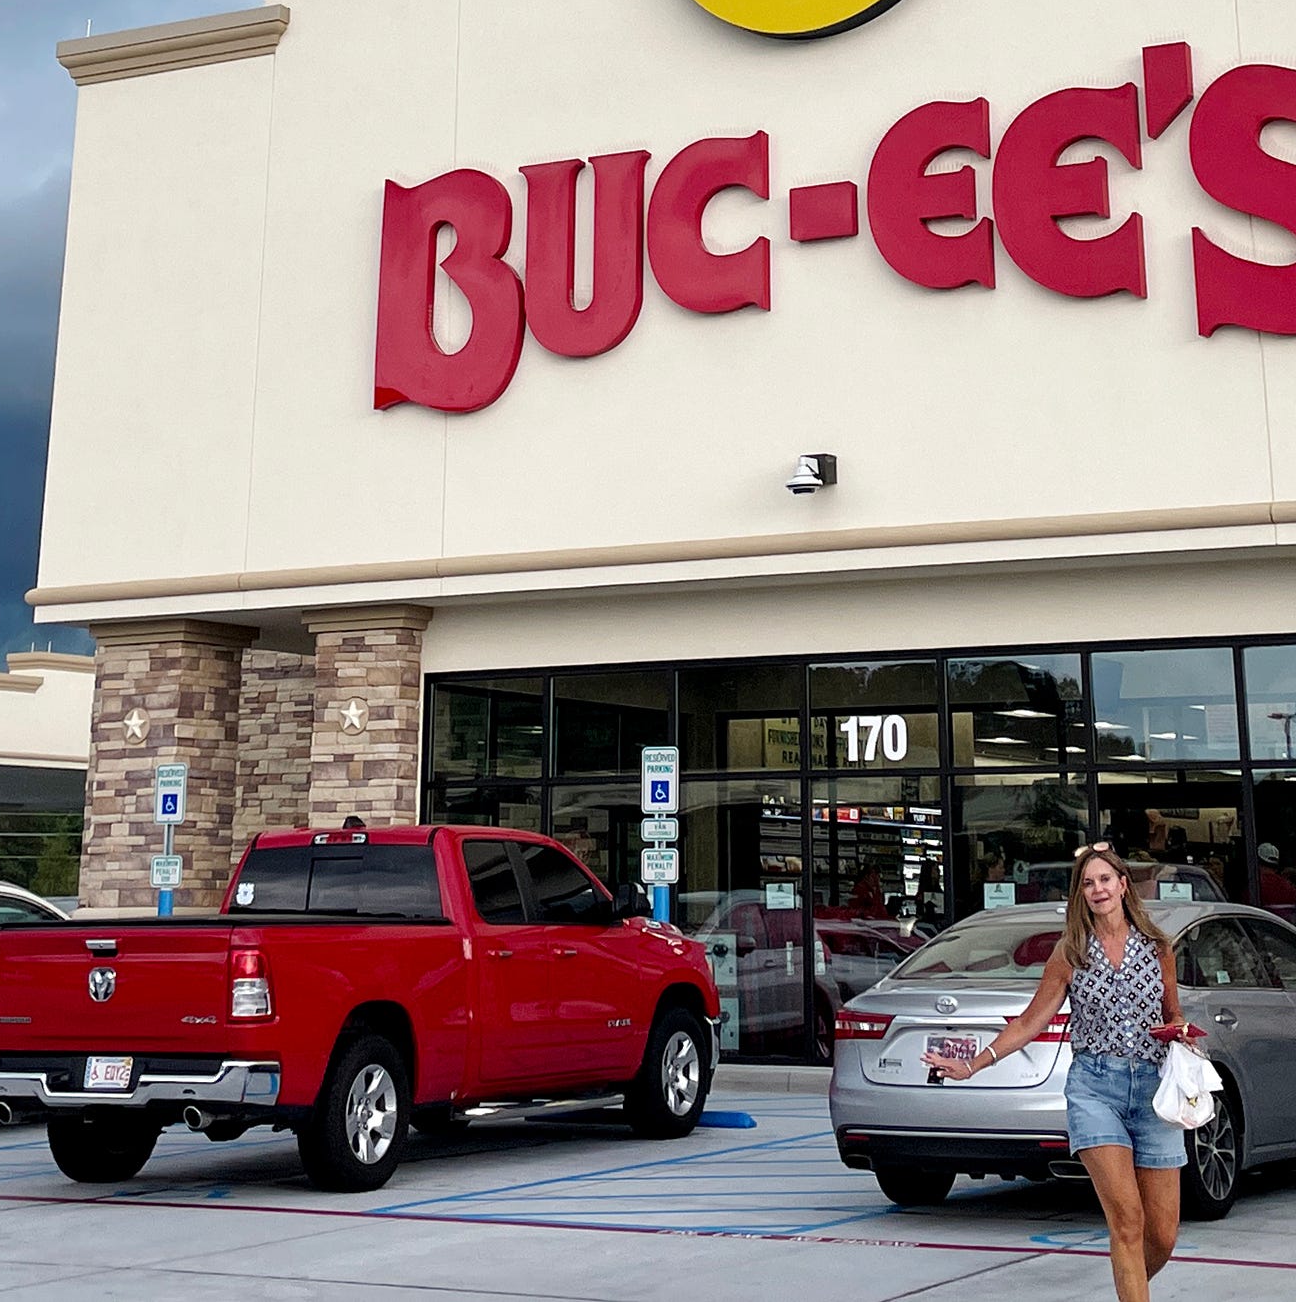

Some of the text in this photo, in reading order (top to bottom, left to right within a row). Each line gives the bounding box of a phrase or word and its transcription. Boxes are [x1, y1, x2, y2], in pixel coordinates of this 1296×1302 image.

[840, 714, 908, 762] 170
[644, 753, 676, 763] RESERVED
[647, 764, 674, 774] PARKING
[646, 853, 674, 861] MAXIMUM
[646, 862, 673, 870] PENALTY
